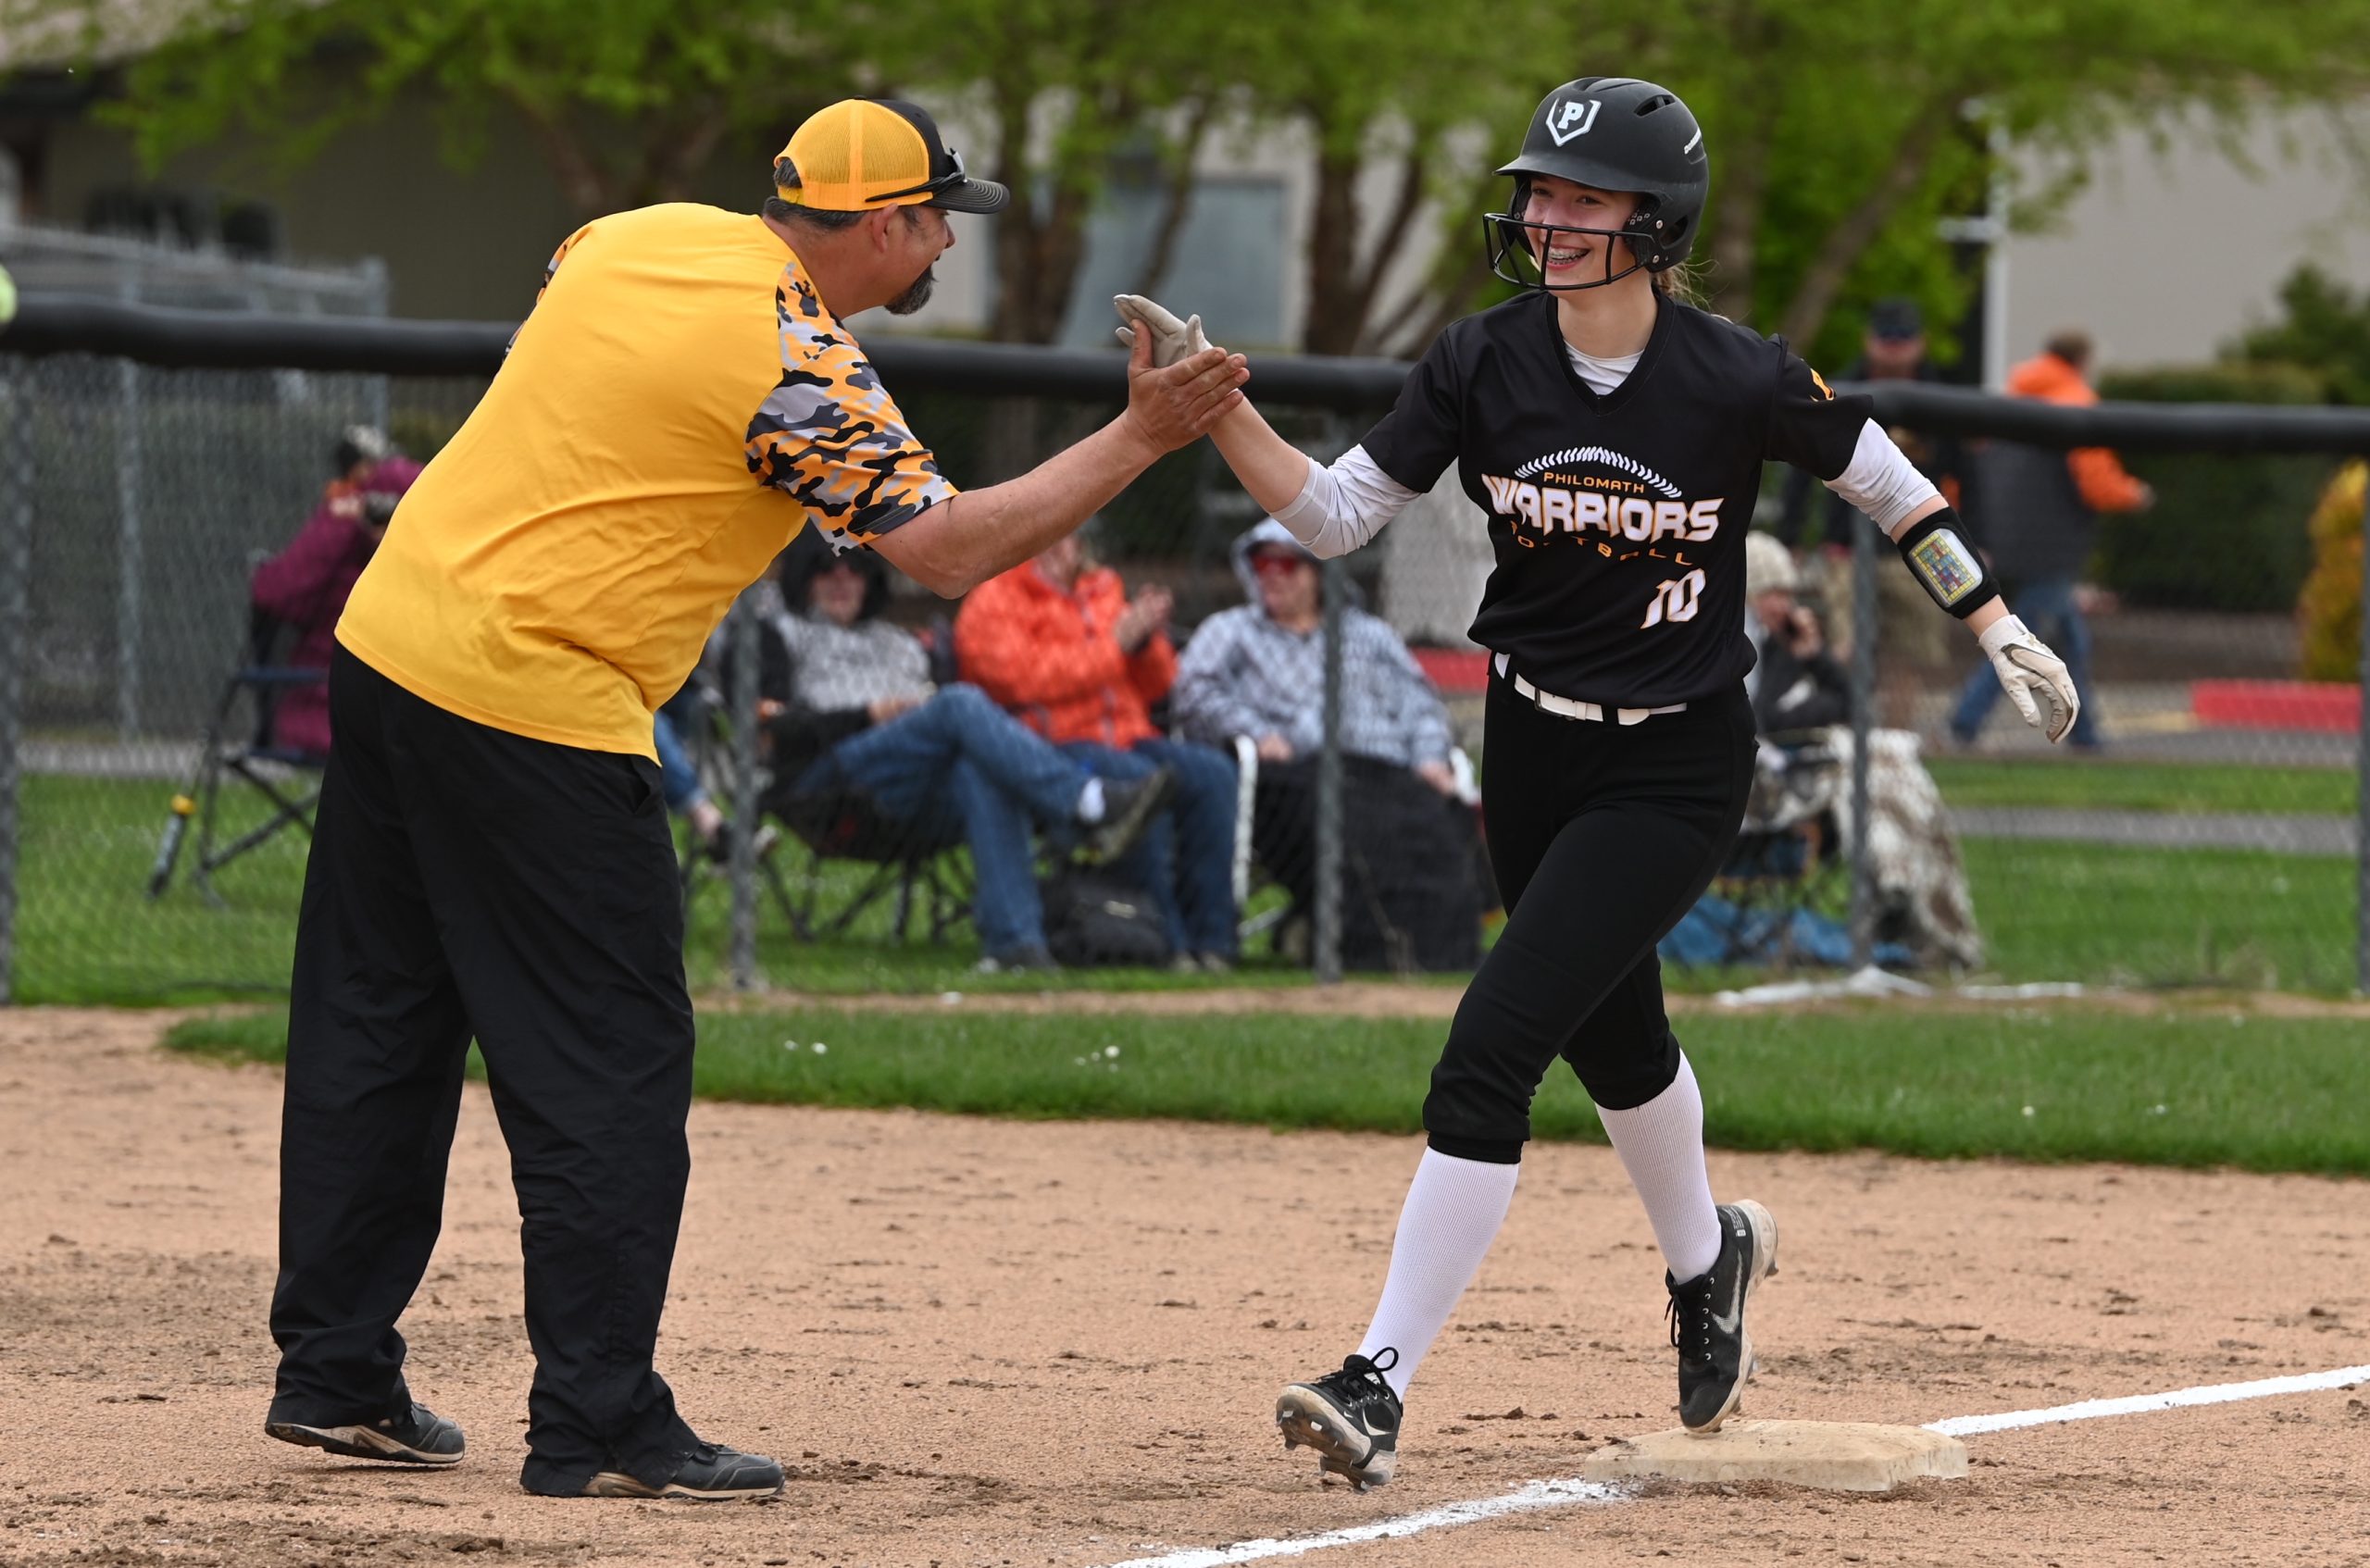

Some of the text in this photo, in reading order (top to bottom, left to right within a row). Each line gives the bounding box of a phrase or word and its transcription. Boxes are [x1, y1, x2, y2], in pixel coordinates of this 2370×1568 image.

[1557, 100, 1584, 130] P
[1543, 471, 1645, 493] PHILOMATH
[1481, 473, 1725, 544] WARRIORS
[1640, 567, 1706, 630] 10
